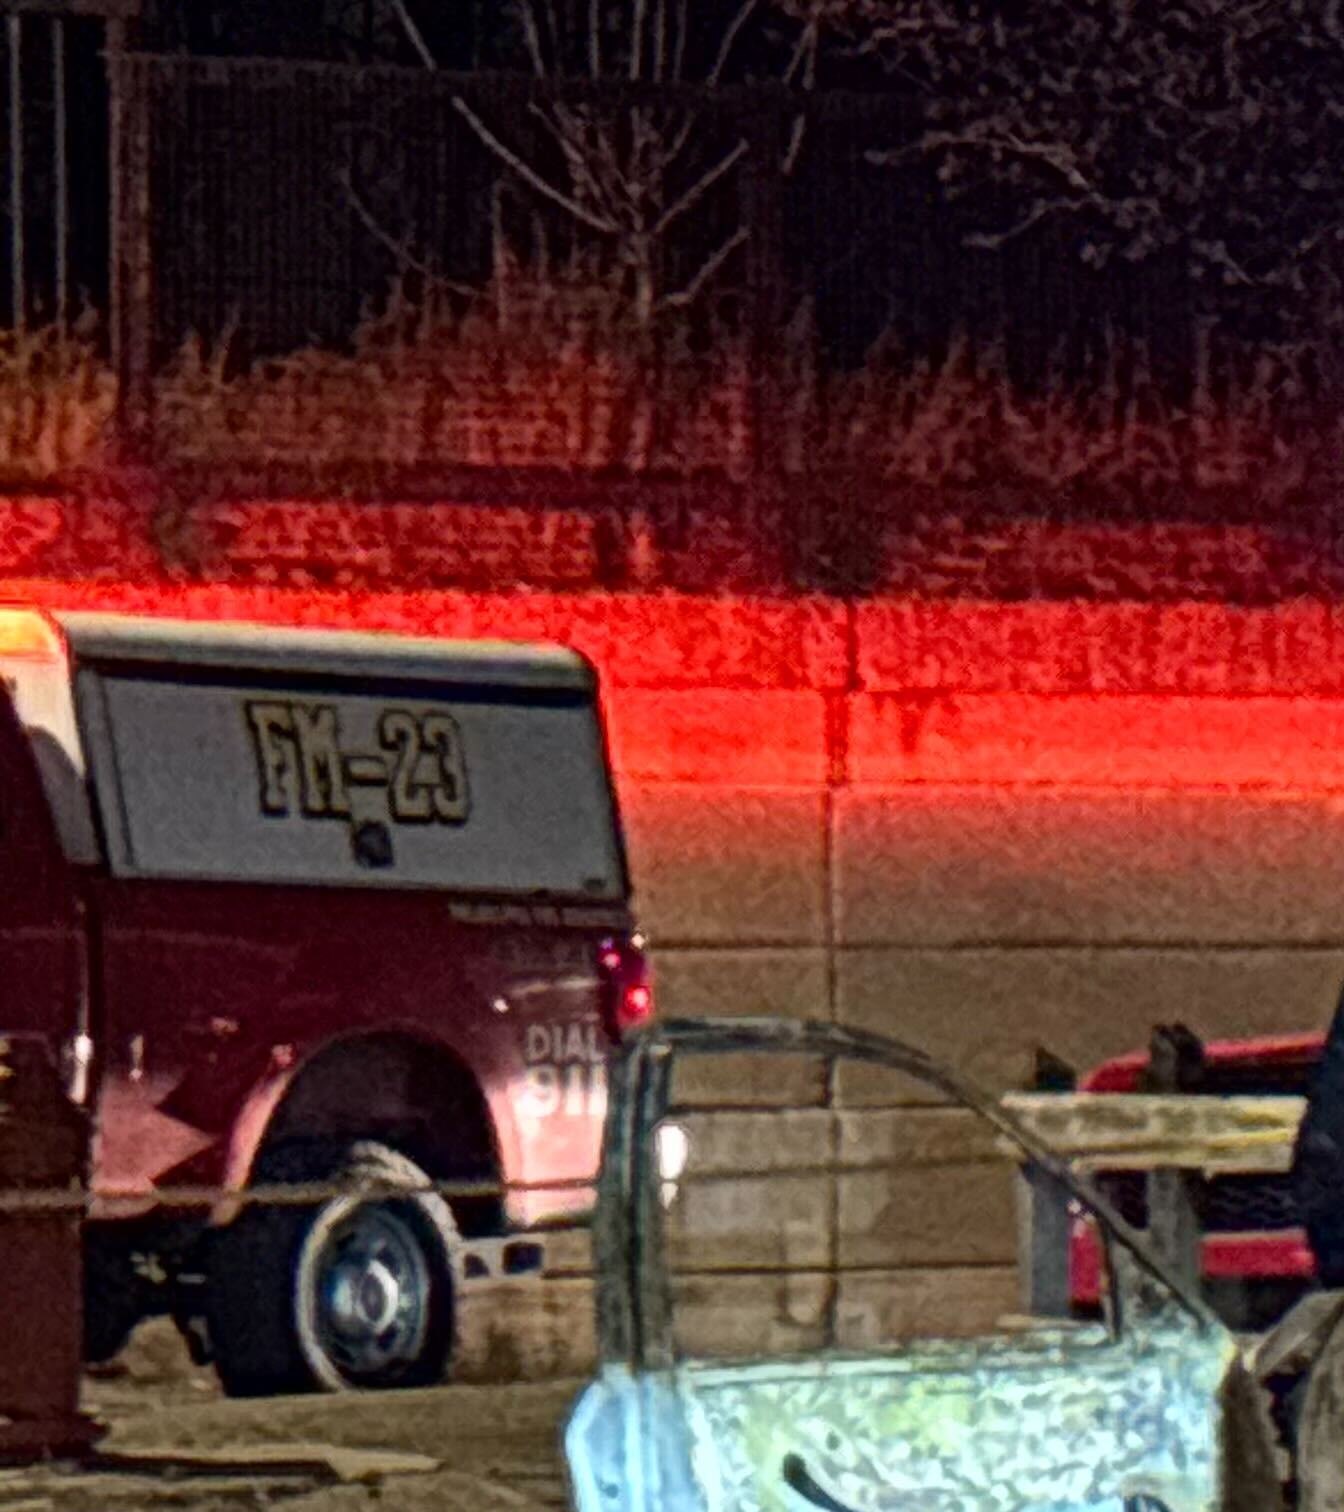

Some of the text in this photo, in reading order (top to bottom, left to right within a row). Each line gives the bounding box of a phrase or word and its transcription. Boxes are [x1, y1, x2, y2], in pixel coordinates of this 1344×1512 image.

[245, 698, 471, 825] FM-23
[526, 1024, 606, 1063] DIAL
[513, 1063, 607, 1118] 911
